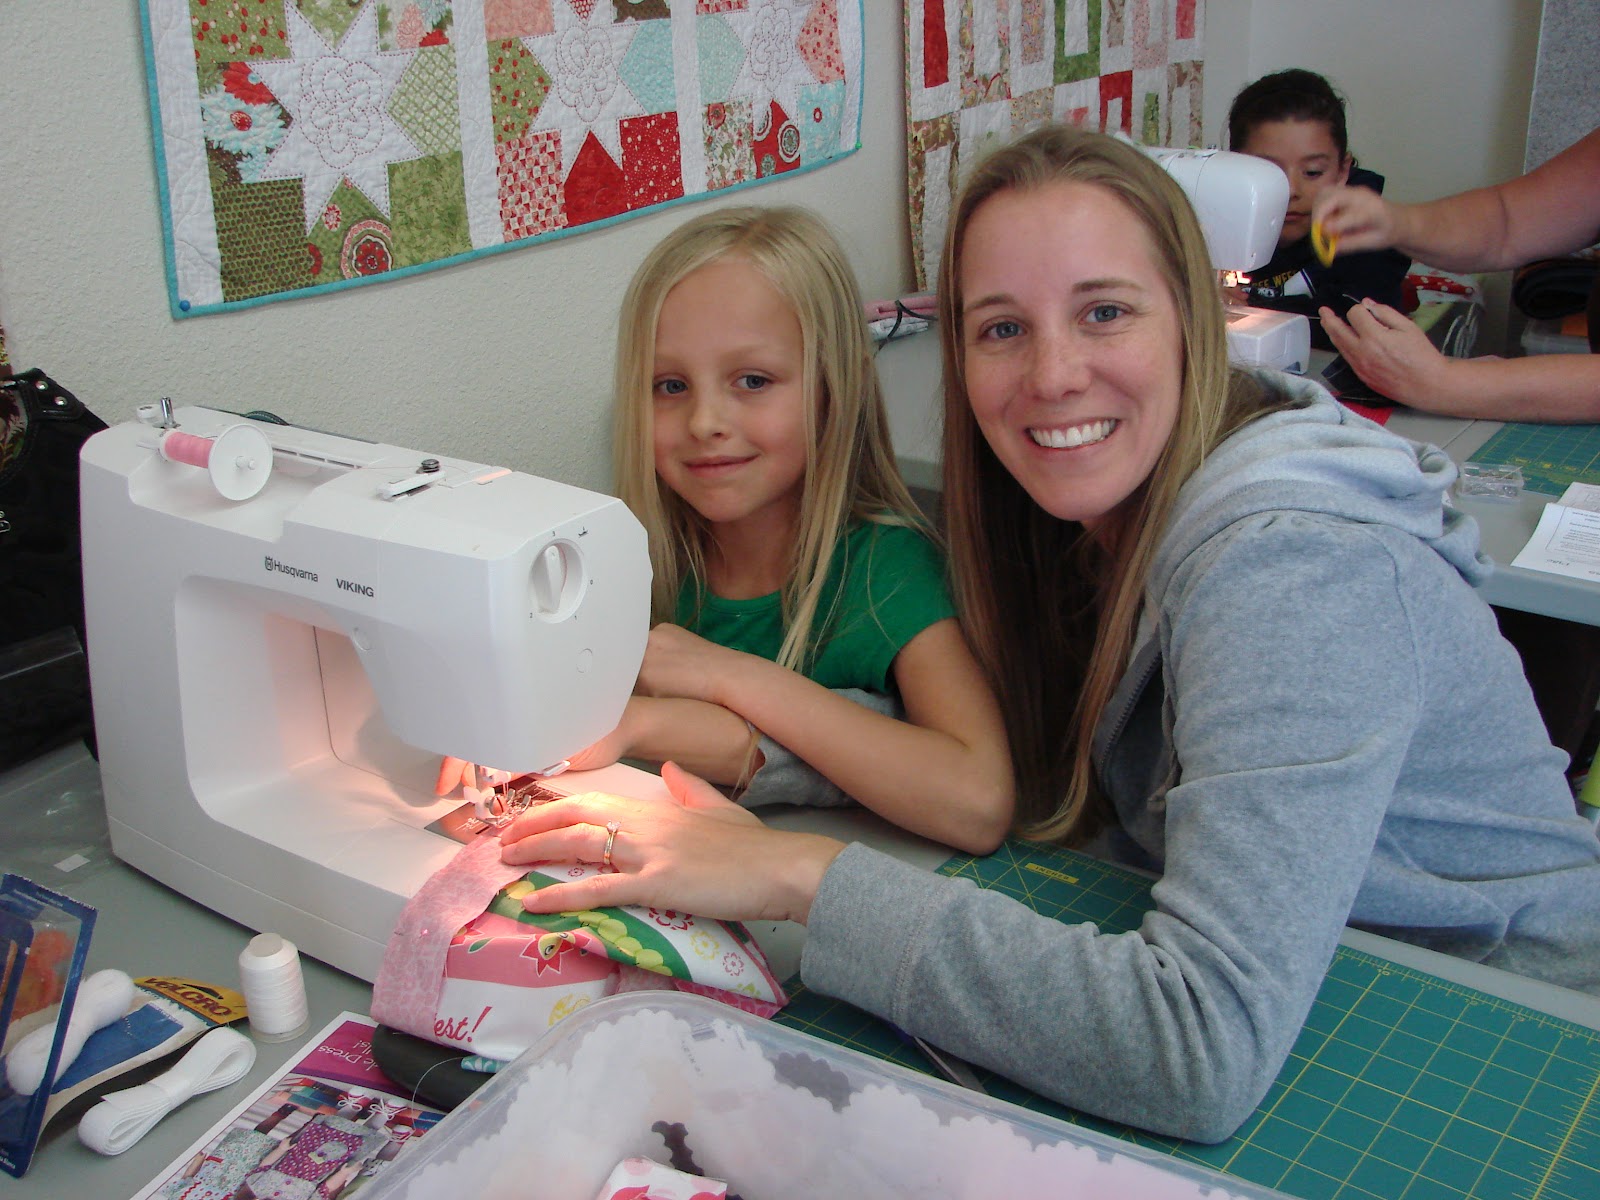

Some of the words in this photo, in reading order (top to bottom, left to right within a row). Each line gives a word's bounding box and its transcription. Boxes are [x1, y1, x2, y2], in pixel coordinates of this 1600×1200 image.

[273, 559, 319, 583] Husqvarna
[336, 578, 375, 598] VIKING
[144, 978, 232, 1016] VELCRO
[433, 1006, 493, 1042] est!
[318, 1045, 362, 1064] Dress
